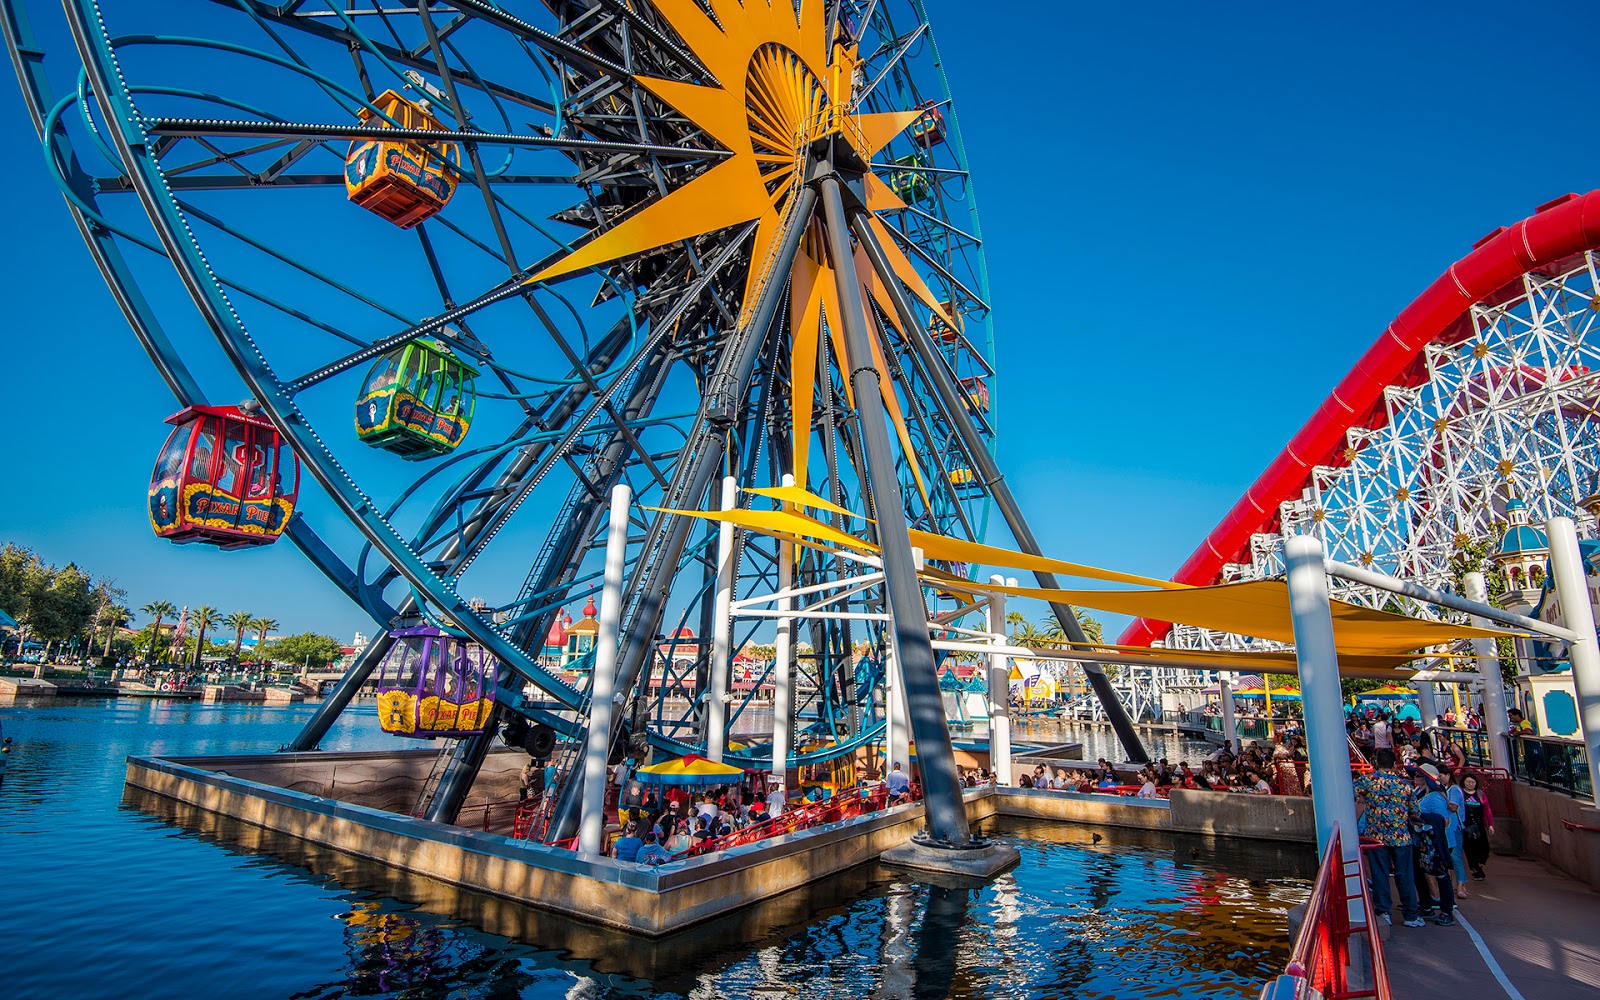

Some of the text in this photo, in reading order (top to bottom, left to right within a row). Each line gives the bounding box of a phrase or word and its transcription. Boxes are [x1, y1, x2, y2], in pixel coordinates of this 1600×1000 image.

[390, 154, 422, 177] PIXAR
[401, 405, 456, 439] PIXAR PIER
[196, 497, 276, 526] PIXAR PIER
[427, 708, 477, 722] PIXAR PIE
